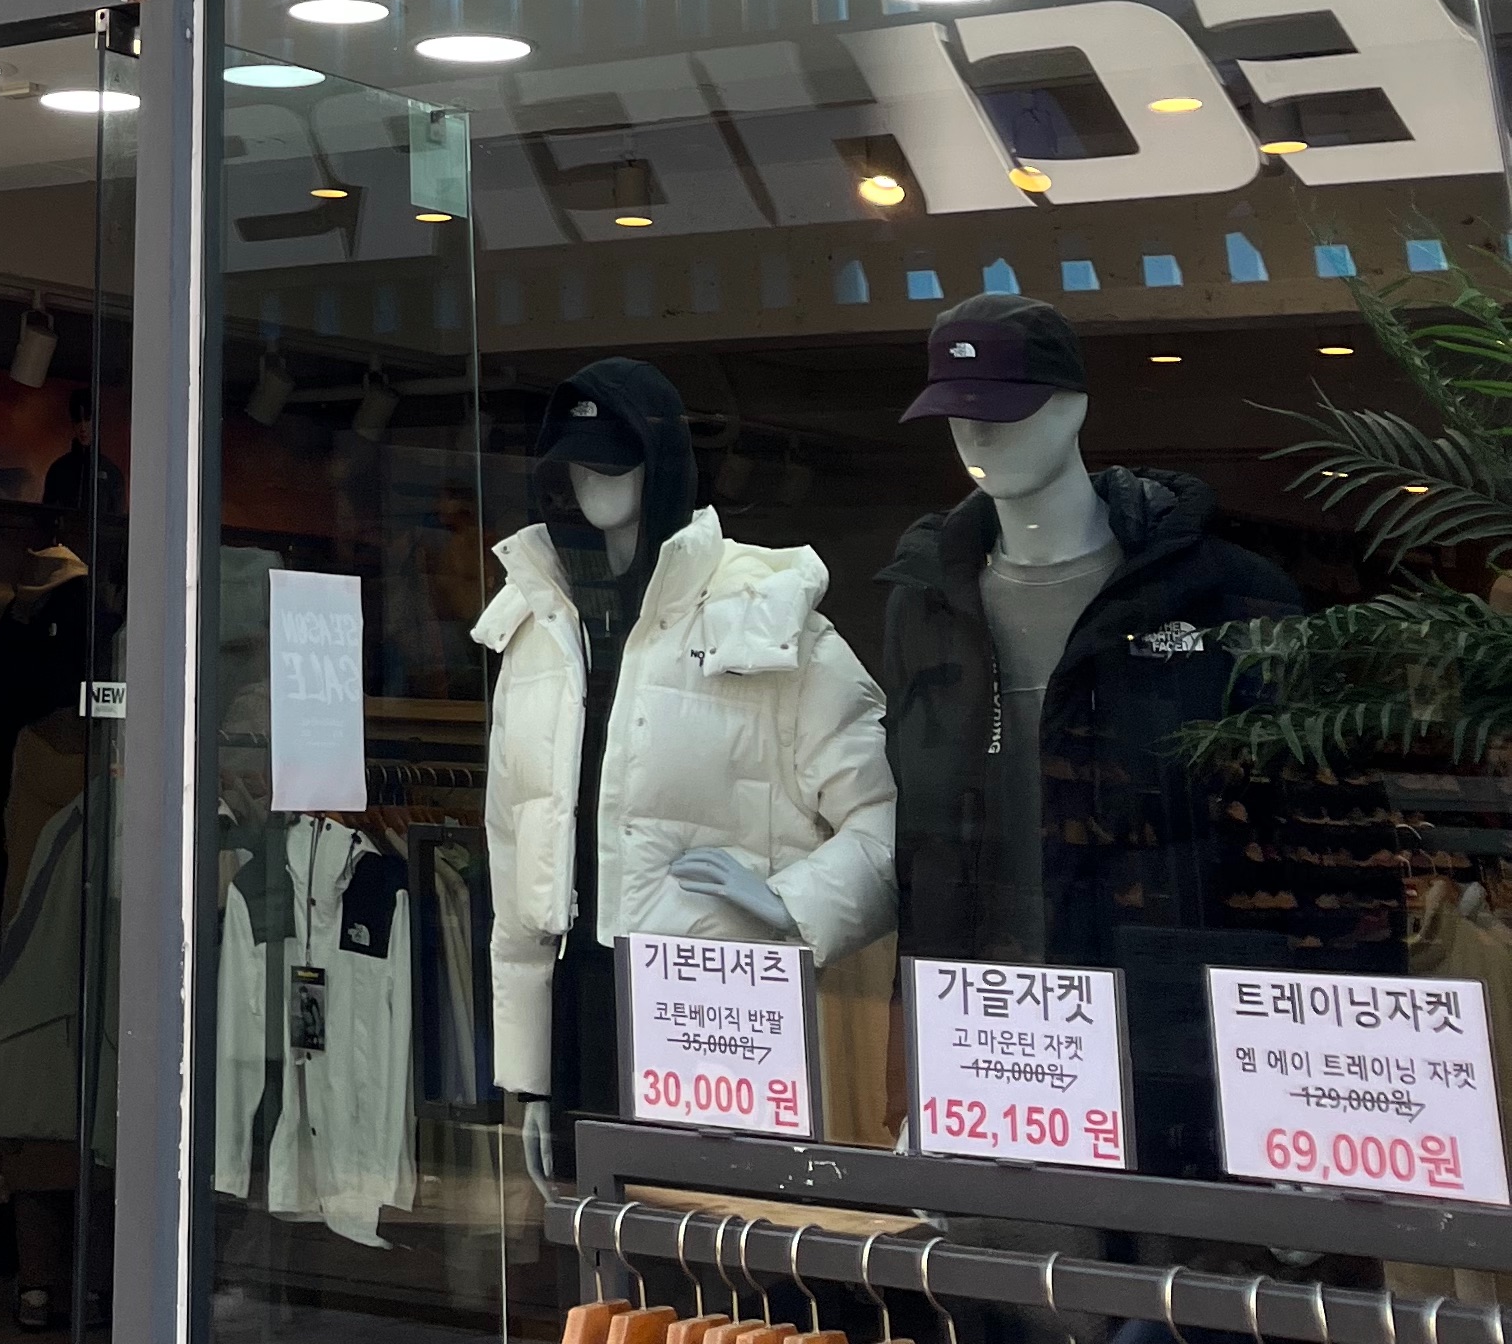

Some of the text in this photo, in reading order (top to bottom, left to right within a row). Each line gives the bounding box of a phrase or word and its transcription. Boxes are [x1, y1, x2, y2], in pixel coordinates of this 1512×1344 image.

[92, 687, 126, 704] NEW
[644, 942, 790, 986] 기본티셔츠
[653, 1001, 784, 1035] 코튼베이직 반팔
[937, 967, 1094, 1025] 가을자켓
[1235, 982, 1465, 1035] 트레이닝자켓
[681, 1031, 756, 1061] 35,000원
[952, 1027, 1084, 1062] 고 마운틴 자켓
[970, 1057, 1066, 1091] 179,000원
[1235, 1046, 1478, 1090] 엠 에이 트레이닝 자켓
[643, 1068, 800, 1128] 30,000 원
[1300, 1085, 1415, 1118] 129,000원
[923, 1096, 1121, 1161] 152,150 원
[1265, 1127, 1465, 1190] 69,000원
